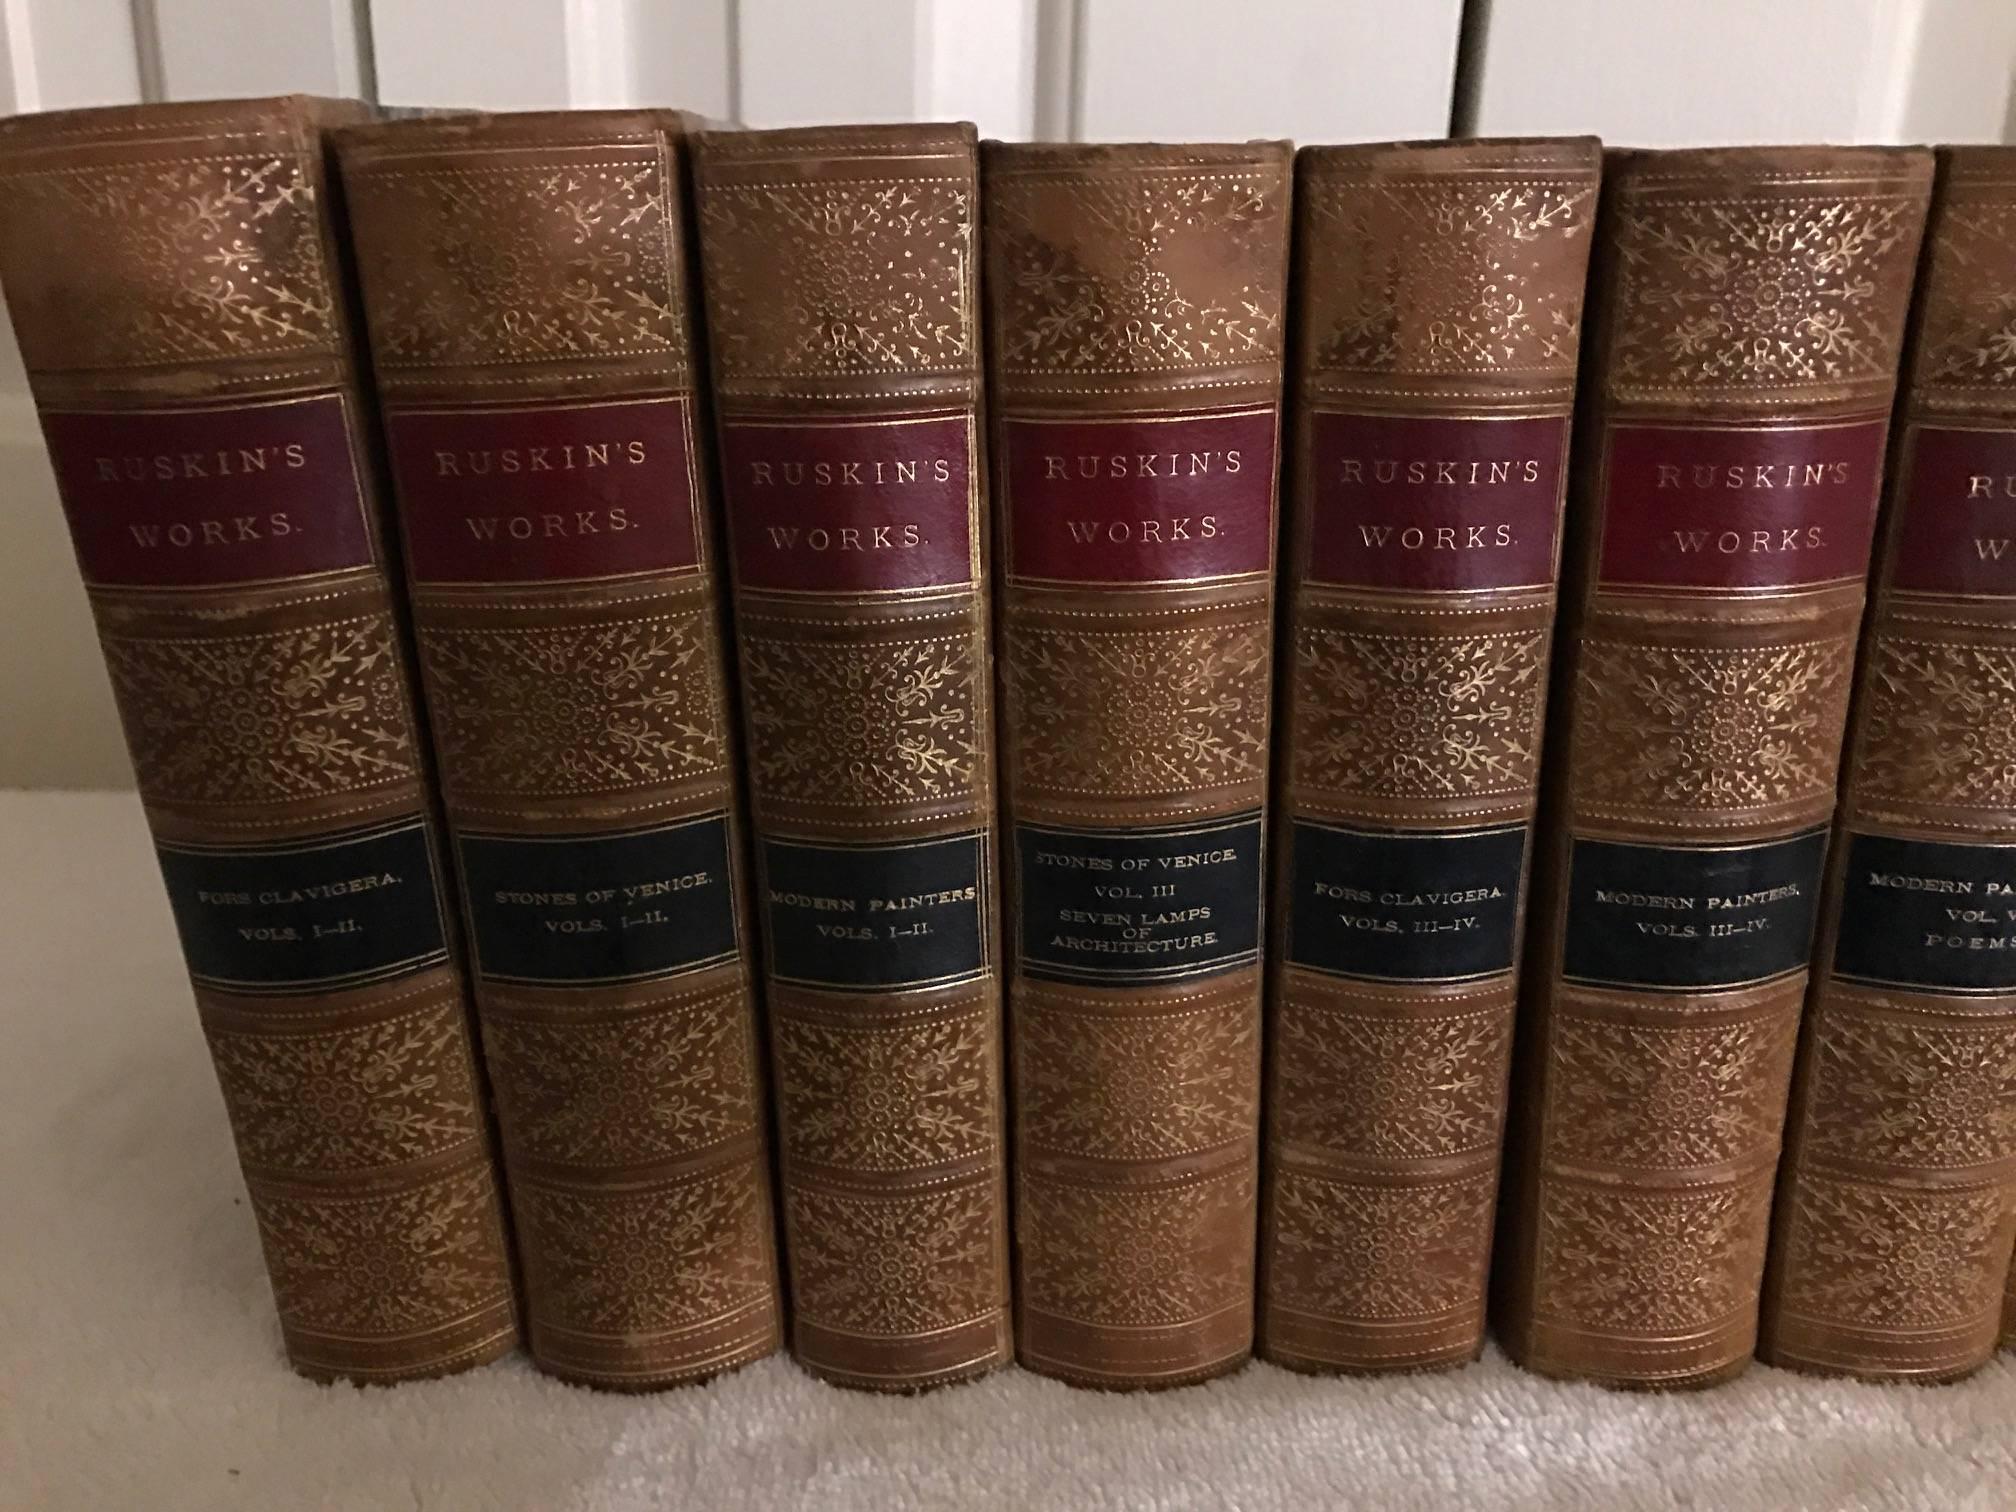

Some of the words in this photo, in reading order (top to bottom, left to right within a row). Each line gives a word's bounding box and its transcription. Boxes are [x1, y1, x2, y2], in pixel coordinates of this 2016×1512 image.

[95, 444, 305, 481] RUSKIN'S
[436, 441, 646, 476] RUSKIN'S
[1044, 450, 1241, 481] RUSKIN'S
[751, 459, 950, 486] RUSKIN'S
[1340, 460, 1539, 486] RUSKIN'S
[1657, 462, 1848, 489] RUSKIN'S
[129, 512, 304, 548] WORKS.
[465, 508, 640, 541] WORKS.
[767, 524, 930, 552] WORKS.
[1067, 515, 1225, 544] WORKS.
[1358, 524, 1519, 551] WORKS.
[1673, 526, 1828, 554] WORKS.
[1035, 851, 1113, 870] STONES
[1121, 858, 1151, 871] OF
[258, 872, 402, 905] CLAVIGERA.
[495, 890, 577, 906] STONES
[585, 889, 616, 904] OF
[623, 872, 712, 899] VENICE.
[1094, 885, 1143, 899] VOL.
[1152, 884, 1176, 898] III
[1314, 881, 1372, 903] FORS
[1868, 871, 1974, 895] MODERN
[768, 889, 856, 912] MODERN
[869, 886, 976, 912] PAINTERS
[1595, 888, 1695, 910] MODERN
[1708, 883, 1800, 911] PAINTERS.
[545, 919, 608, 934] VOLS.
[1059, 909, 1132, 926] SEVEN
[1141, 906, 1211, 925] LAMPS
[1338, 913, 1403, 934] VOLS.
[1946, 908, 1998, 923] VOL.
[817, 924, 878, 940] VOLS.
[1050, 932, 1219, 954] ARCHITECTURE.
[1122, 927, 1152, 940] OF
